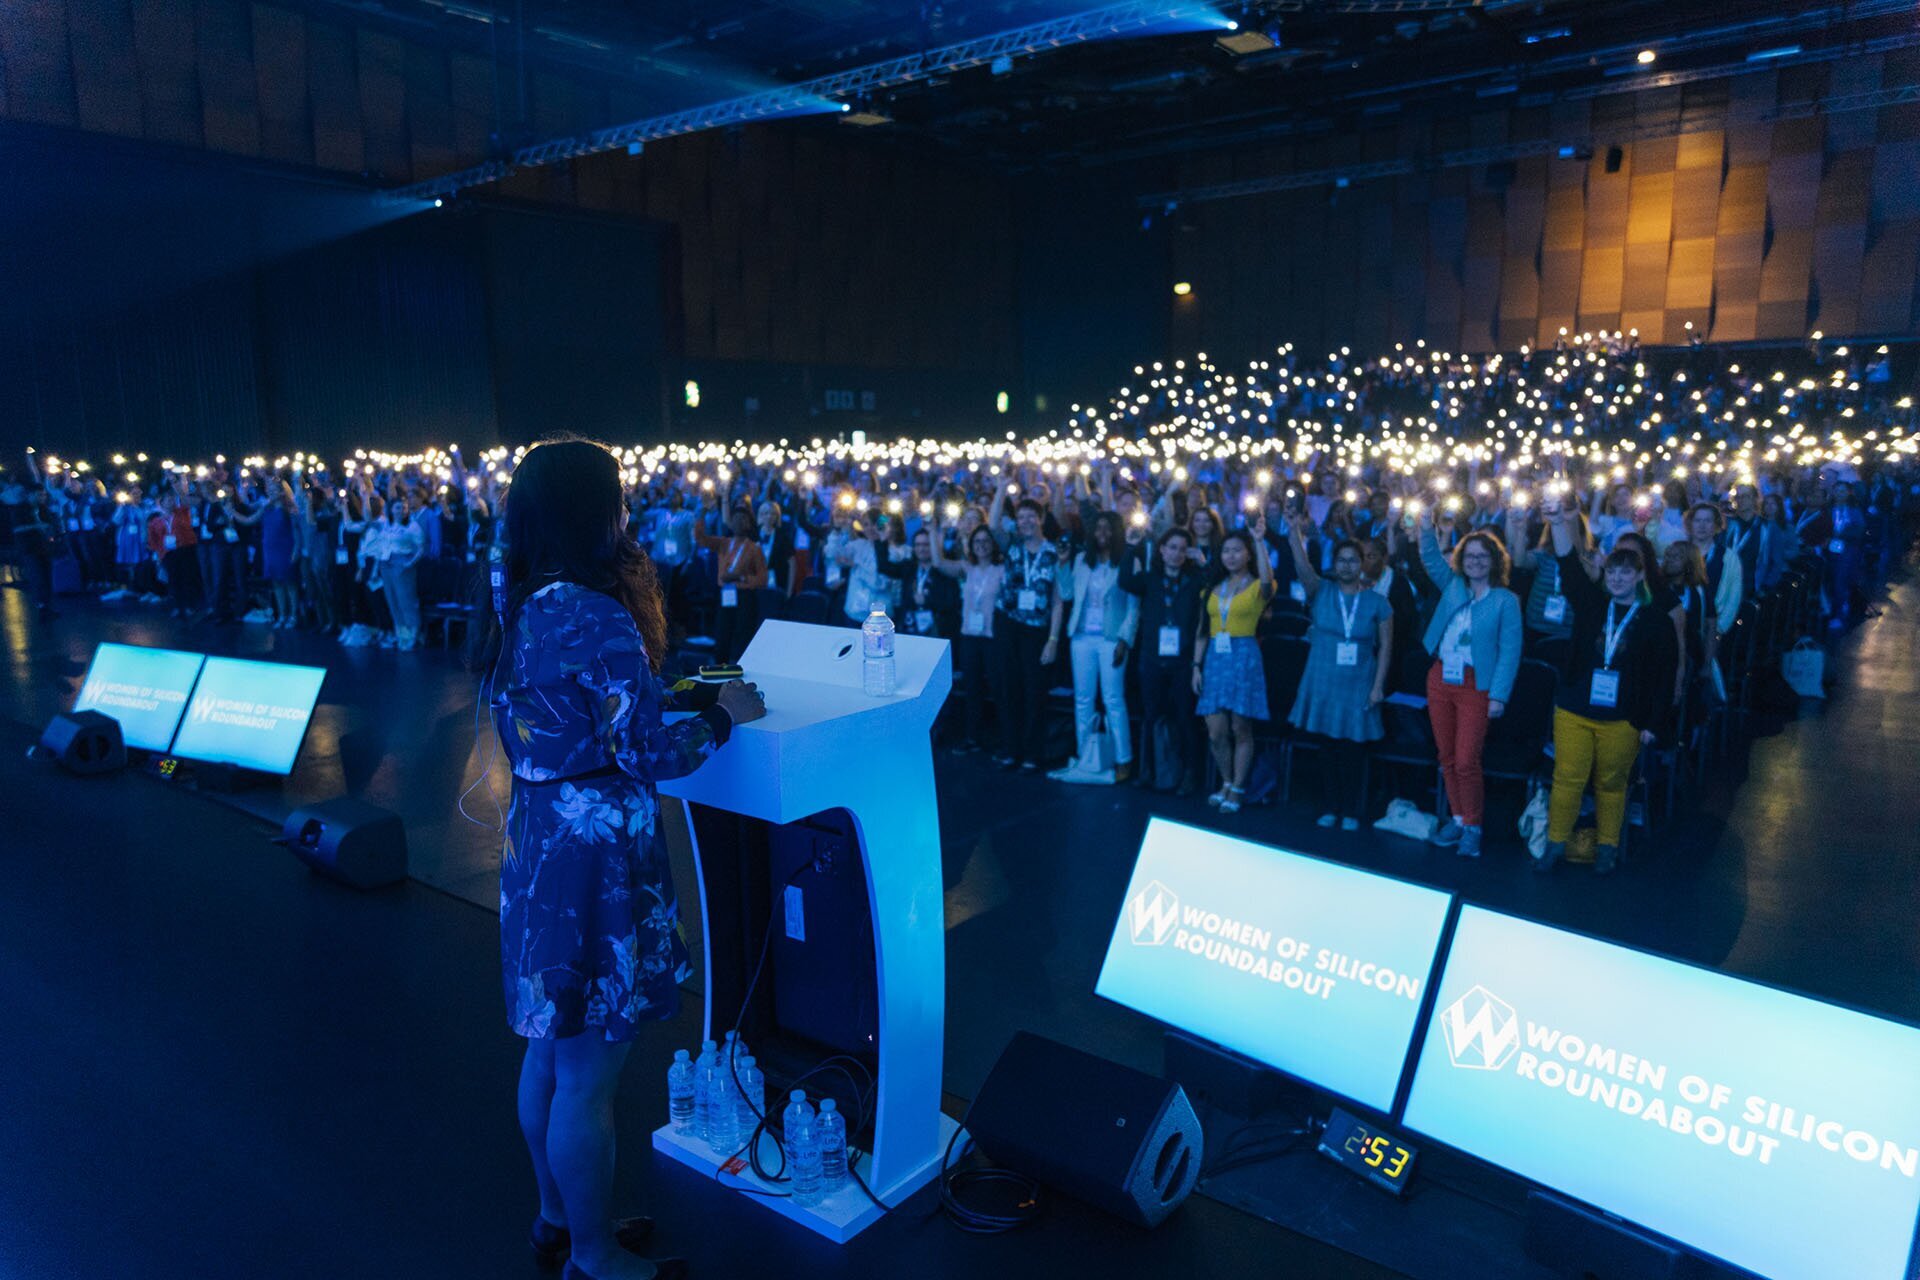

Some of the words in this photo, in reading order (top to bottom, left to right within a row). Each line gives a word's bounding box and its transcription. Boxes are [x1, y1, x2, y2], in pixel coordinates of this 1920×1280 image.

[1173, 929, 1337, 1000] ROUNDABOUT
[1182, 905, 1271, 951] WOMEN
[1277, 937, 1311, 962] OF
[1315, 949, 1420, 1000] SILICON
[1515, 1051, 1780, 1164] ROUNDABOUT
[1525, 1021, 1667, 1089] WOMEN
[1678, 1075, 1732, 1110] OF
[1742, 1096, 1919, 1177] SILICON
[1344, 1126, 1410, 1178] 2:53
